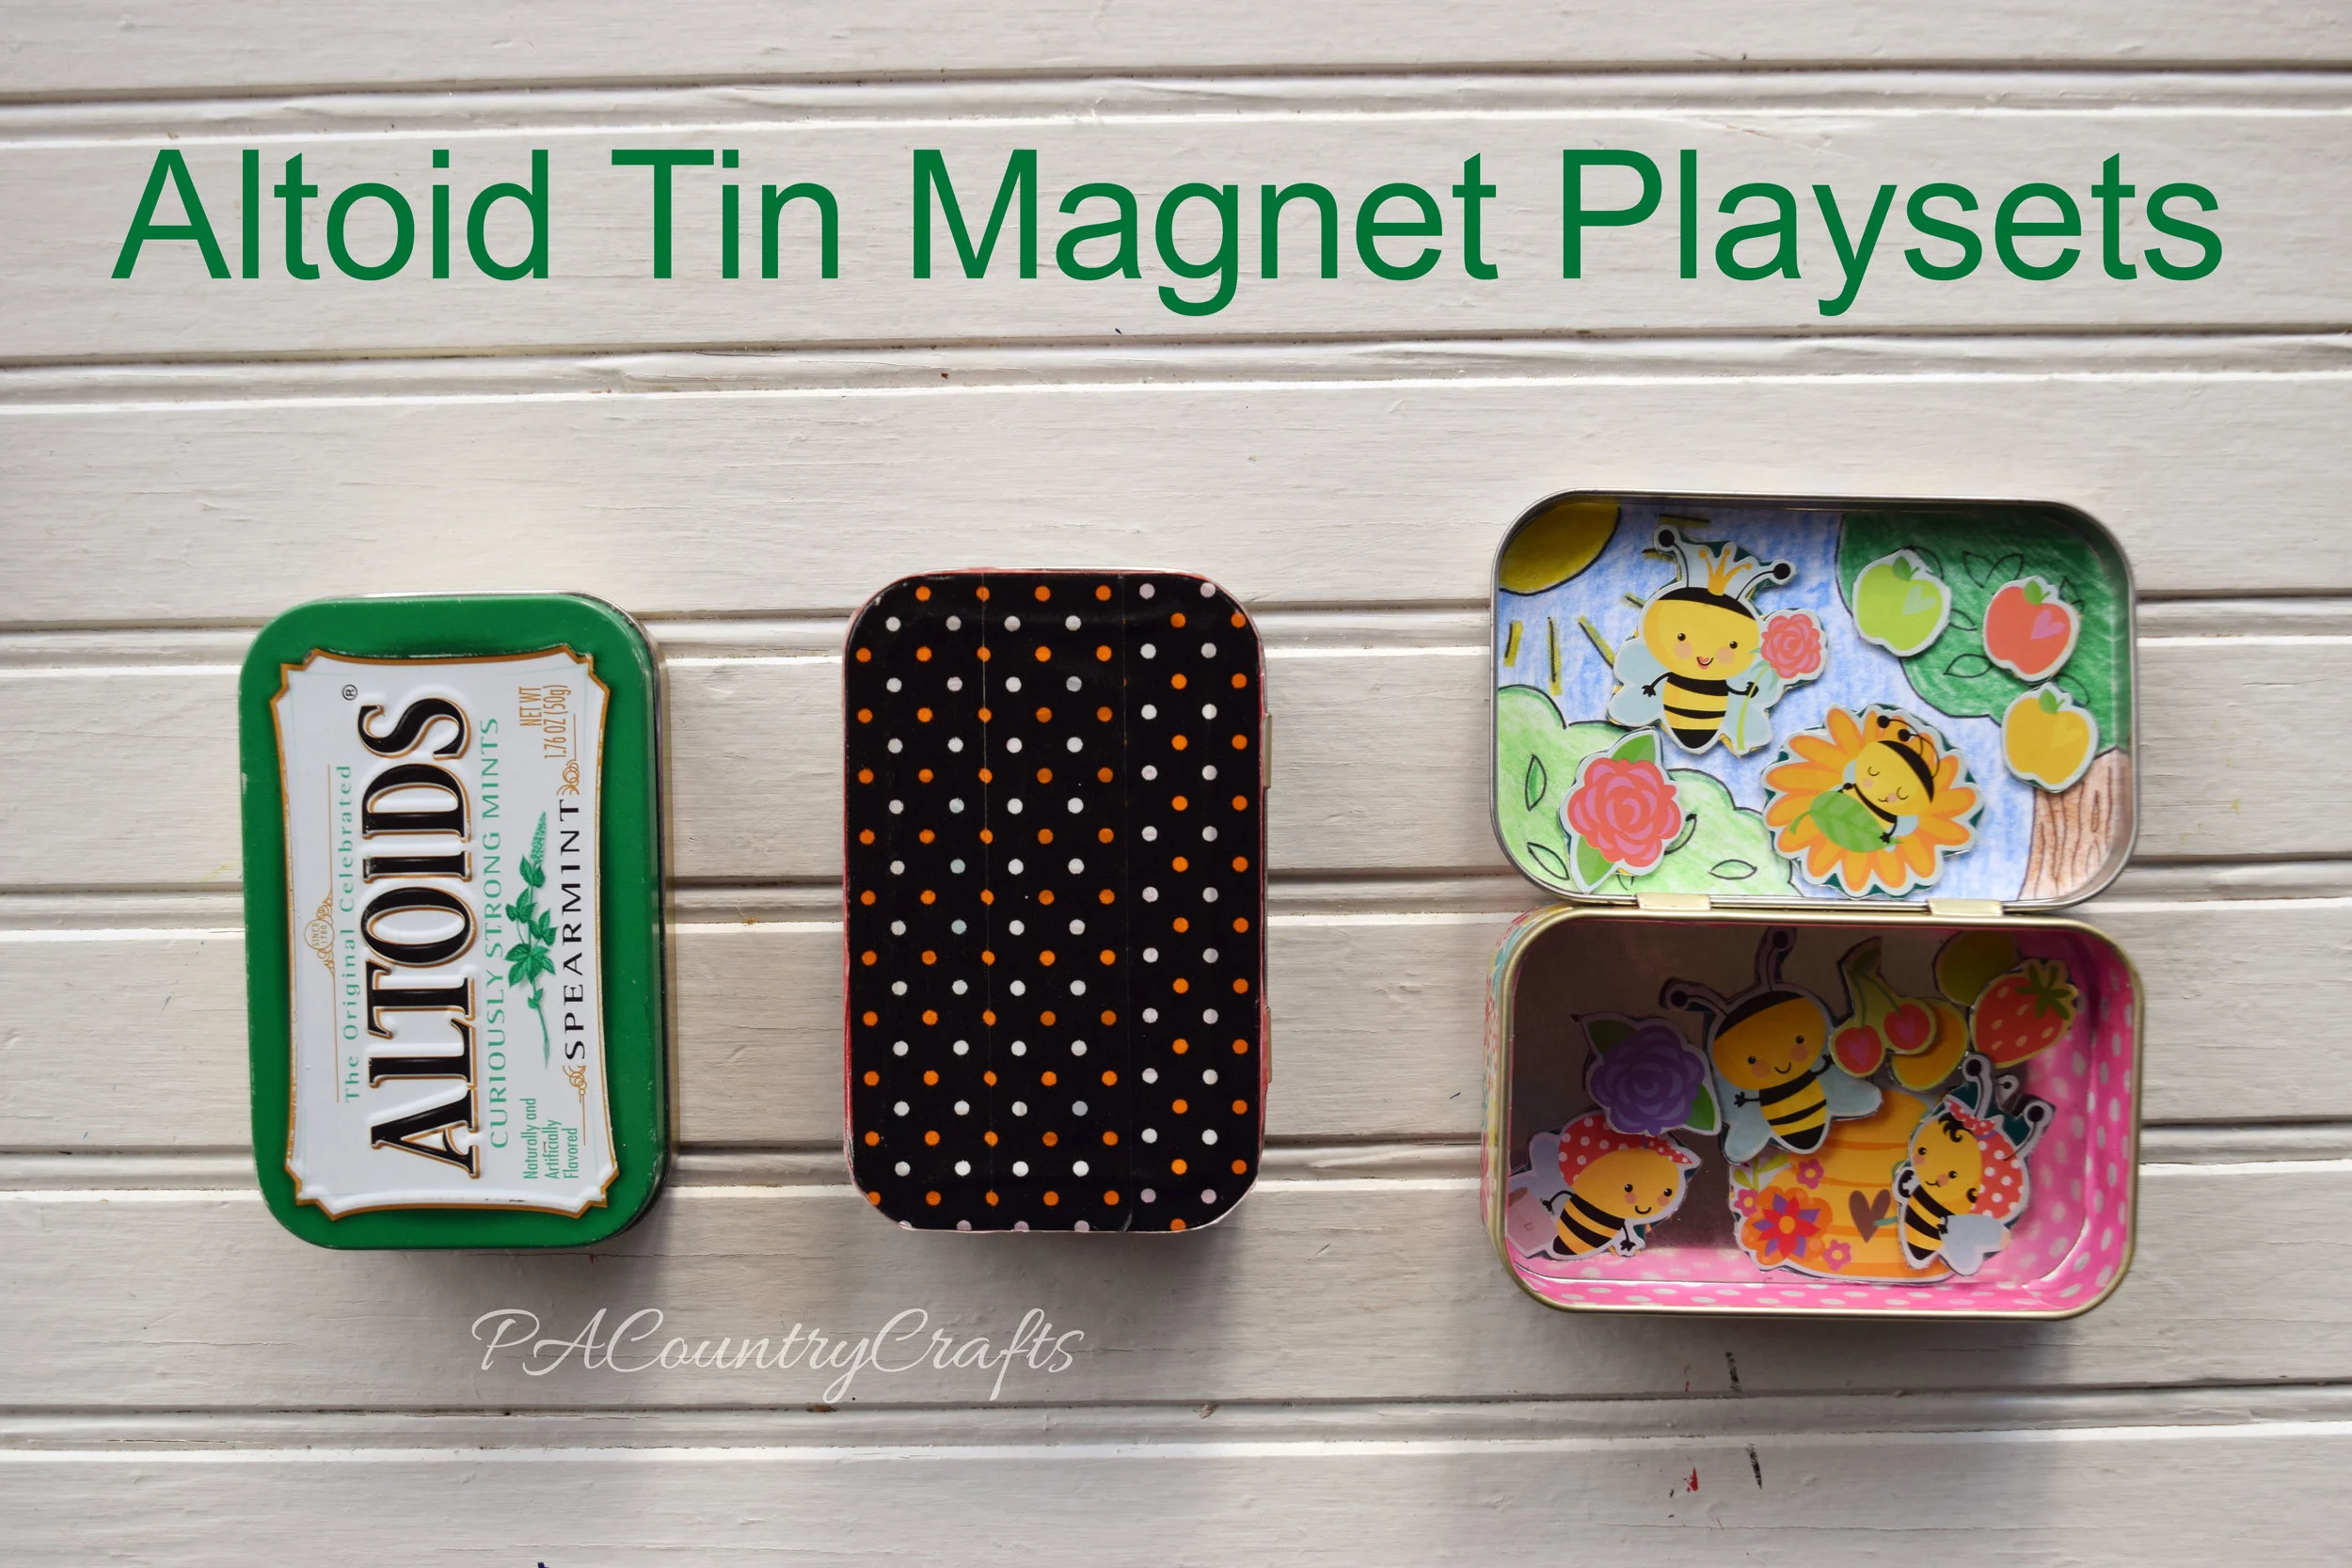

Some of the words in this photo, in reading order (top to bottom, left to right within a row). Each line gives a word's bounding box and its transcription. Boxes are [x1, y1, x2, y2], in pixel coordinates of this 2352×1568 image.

[518, 687, 542, 703] WT
[519, 706, 542, 726] NET
[542, 685, 571, 715] (50g)
[543, 719, 566, 734] OZ
[544, 737, 566, 759] 1.76
[480, 718, 501, 818] MINTS
[336, 766, 355, 912] Celebrated
[482, 832, 502, 958] STRONG
[311, 923, 320, 946] SINCE
[320, 925, 328, 943] 1780
[358, 698, 481, 1179] ALTOIDS
[560, 800, 585, 1060] SPEARMINT
[342, 929, 360, 1040] Original
[345, 1055, 359, 1102] The
[485, 969, 508, 1148] CURIOUSLY
[519, 1099, 537, 1120] and
[520, 1124, 541, 1180] Naturally
[542, 1119, 563, 1180] Artificially
[562, 1128, 579, 1179] Flavored
